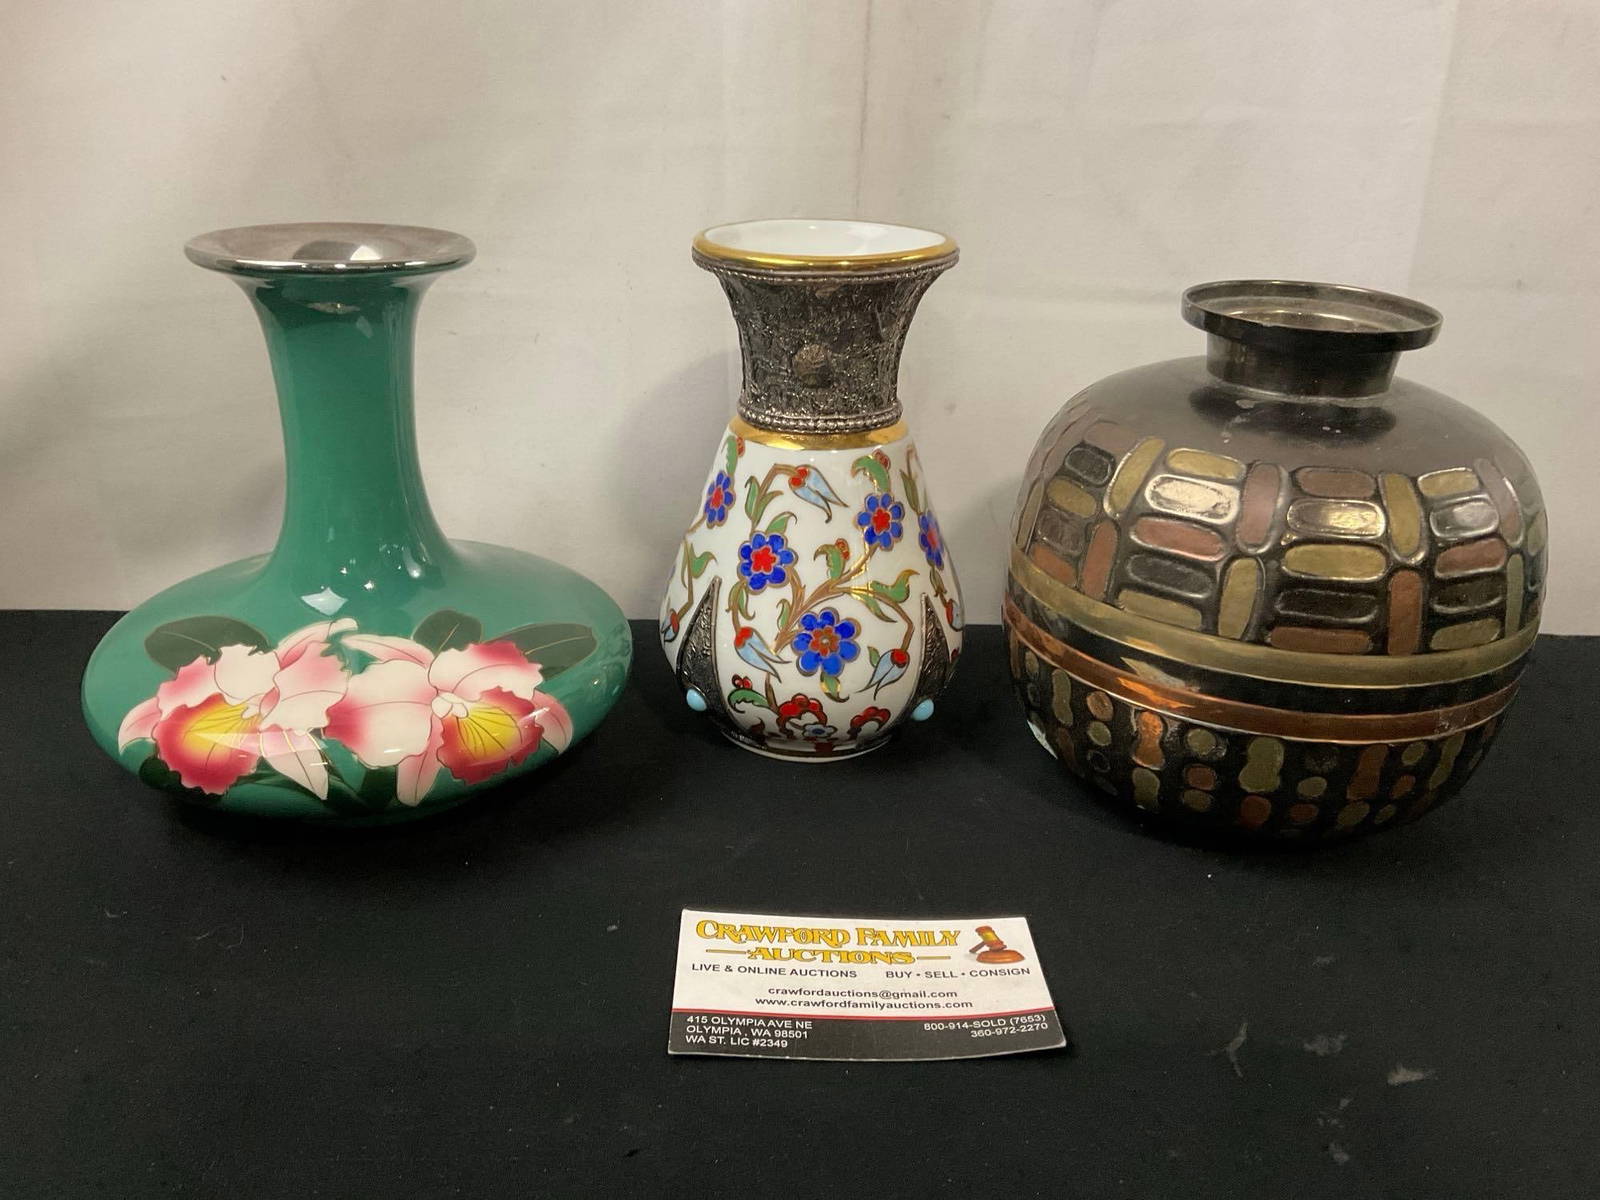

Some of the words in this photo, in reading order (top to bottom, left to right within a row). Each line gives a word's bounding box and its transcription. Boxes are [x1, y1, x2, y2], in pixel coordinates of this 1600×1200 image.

[696, 920, 850, 948] CRAWFORD
[856, 927, 960, 948] FAMILY
[749, 947, 916, 965] AUCTIONS
[692, 963, 720, 972] LIVE
[725, 964, 733, 973] &
[738, 965, 786, 976] ONLINE
[790, 968, 857, 978] AUCTIONS
[886, 970, 912, 978] BUY
[925, 970, 958, 978] SELL
[969, 968, 1031, 977] CONSIGN
[768, 987, 958, 1000] crawfordauctions@gmail.com
[755, 998, 974, 1010] www.crawfordfamilyauctions.com
[686, 1015, 708, 1024] 415
[711, 1016, 765, 1027] OLYMPIA
[769, 1020, 792, 1029] AVE
[796, 1021, 813, 1029] NE
[924, 1018, 1006, 1031] 800-914-SOLD
[1010, 1014, 1046, 1026] (7653)
[751, 1029, 772, 1038] WA
[774, 1030, 808, 1039] 98501
[971, 1022, 1048, 1038] 360-972-2270
[685, 1035, 706, 1044] WA
[709, 1036, 726, 1045] ST.
[731, 1037, 750, 1046] LIC
[752, 1038, 788, 1048] #2349
